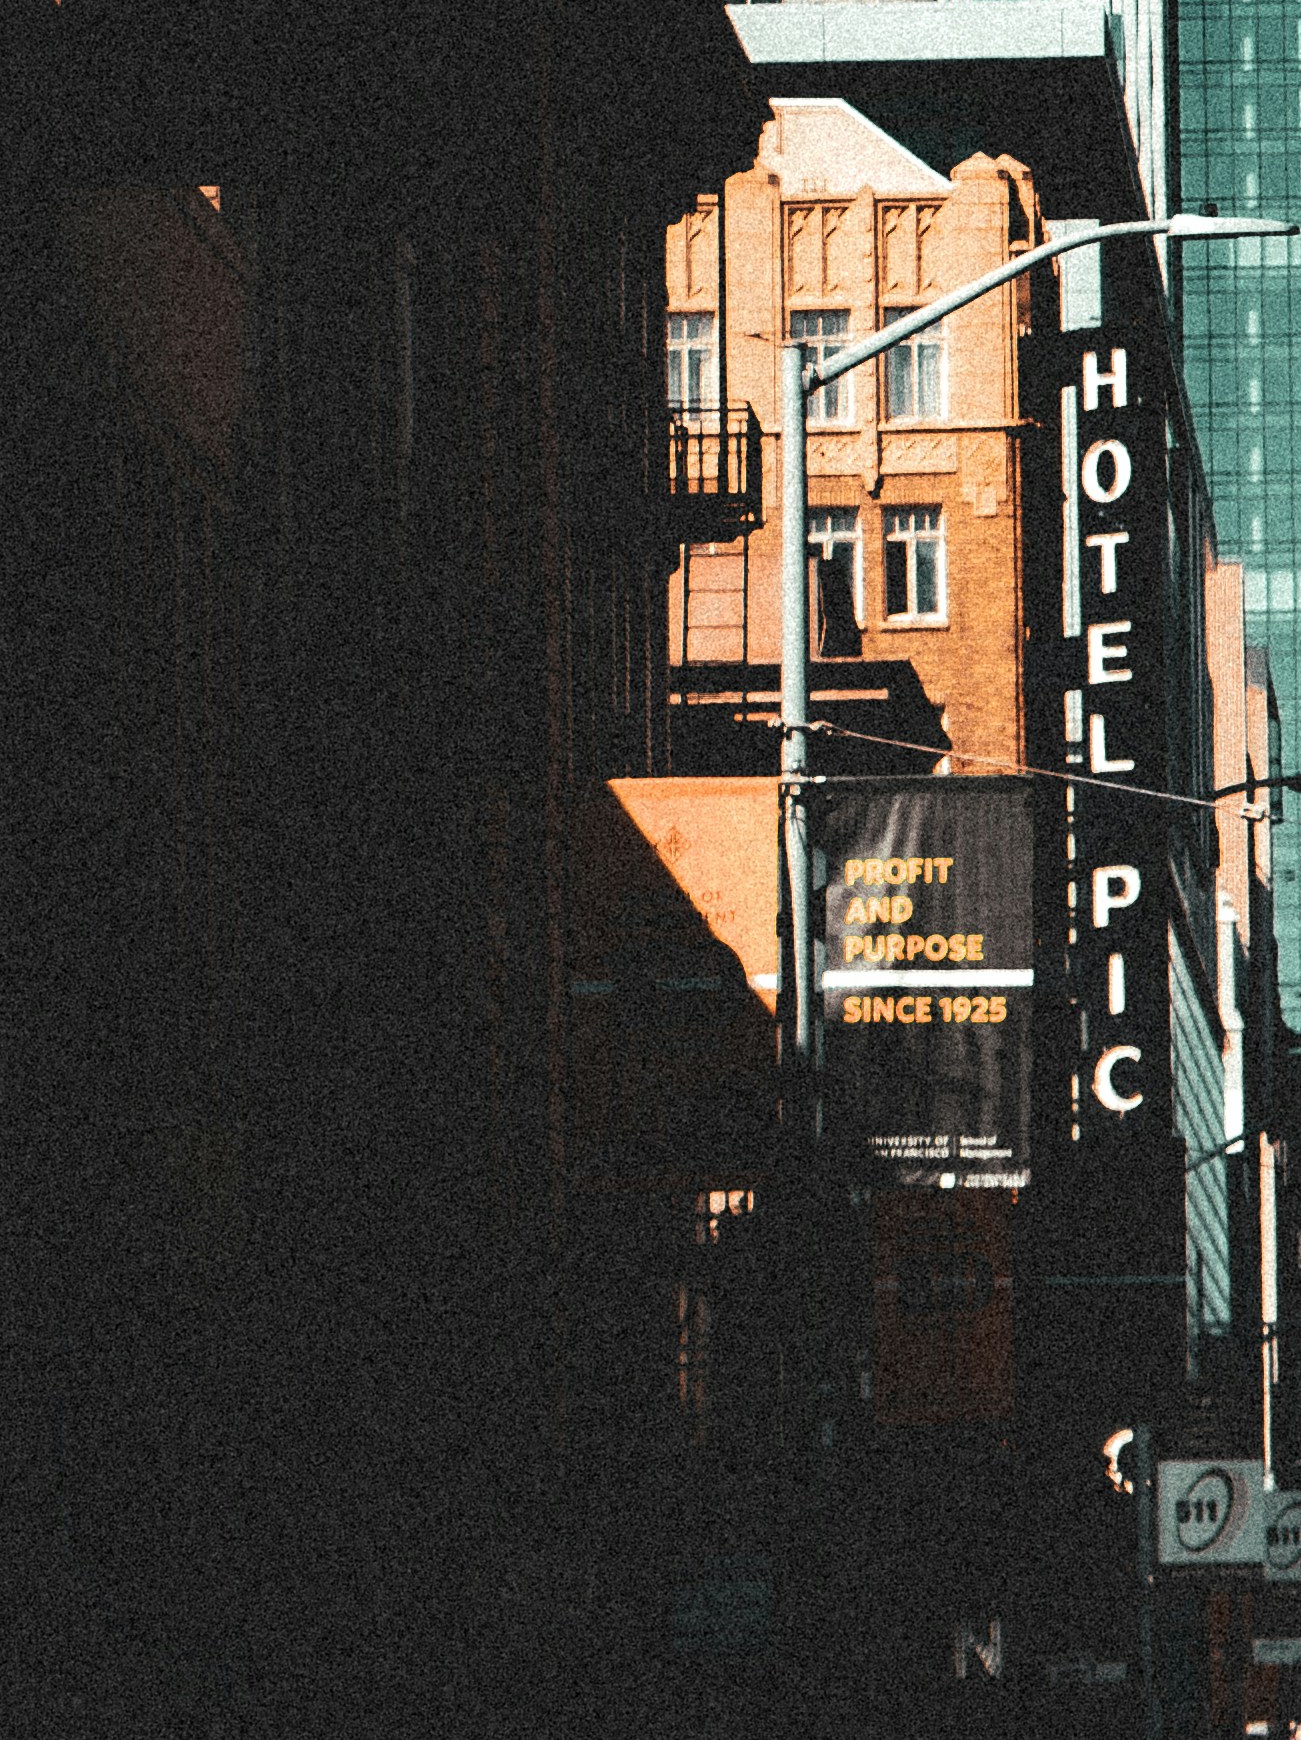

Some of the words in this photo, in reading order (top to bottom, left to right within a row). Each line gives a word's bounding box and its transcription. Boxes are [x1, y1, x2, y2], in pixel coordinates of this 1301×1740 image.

[1081, 347, 1135, 774] HOTEL
[843, 857, 954, 886] PROFIT
[843, 897, 914, 925] AND
[843, 934, 984, 962] PURPOSE
[842, 996, 932, 1024] SINCE
[938, 996, 1007, 1024] 1925
